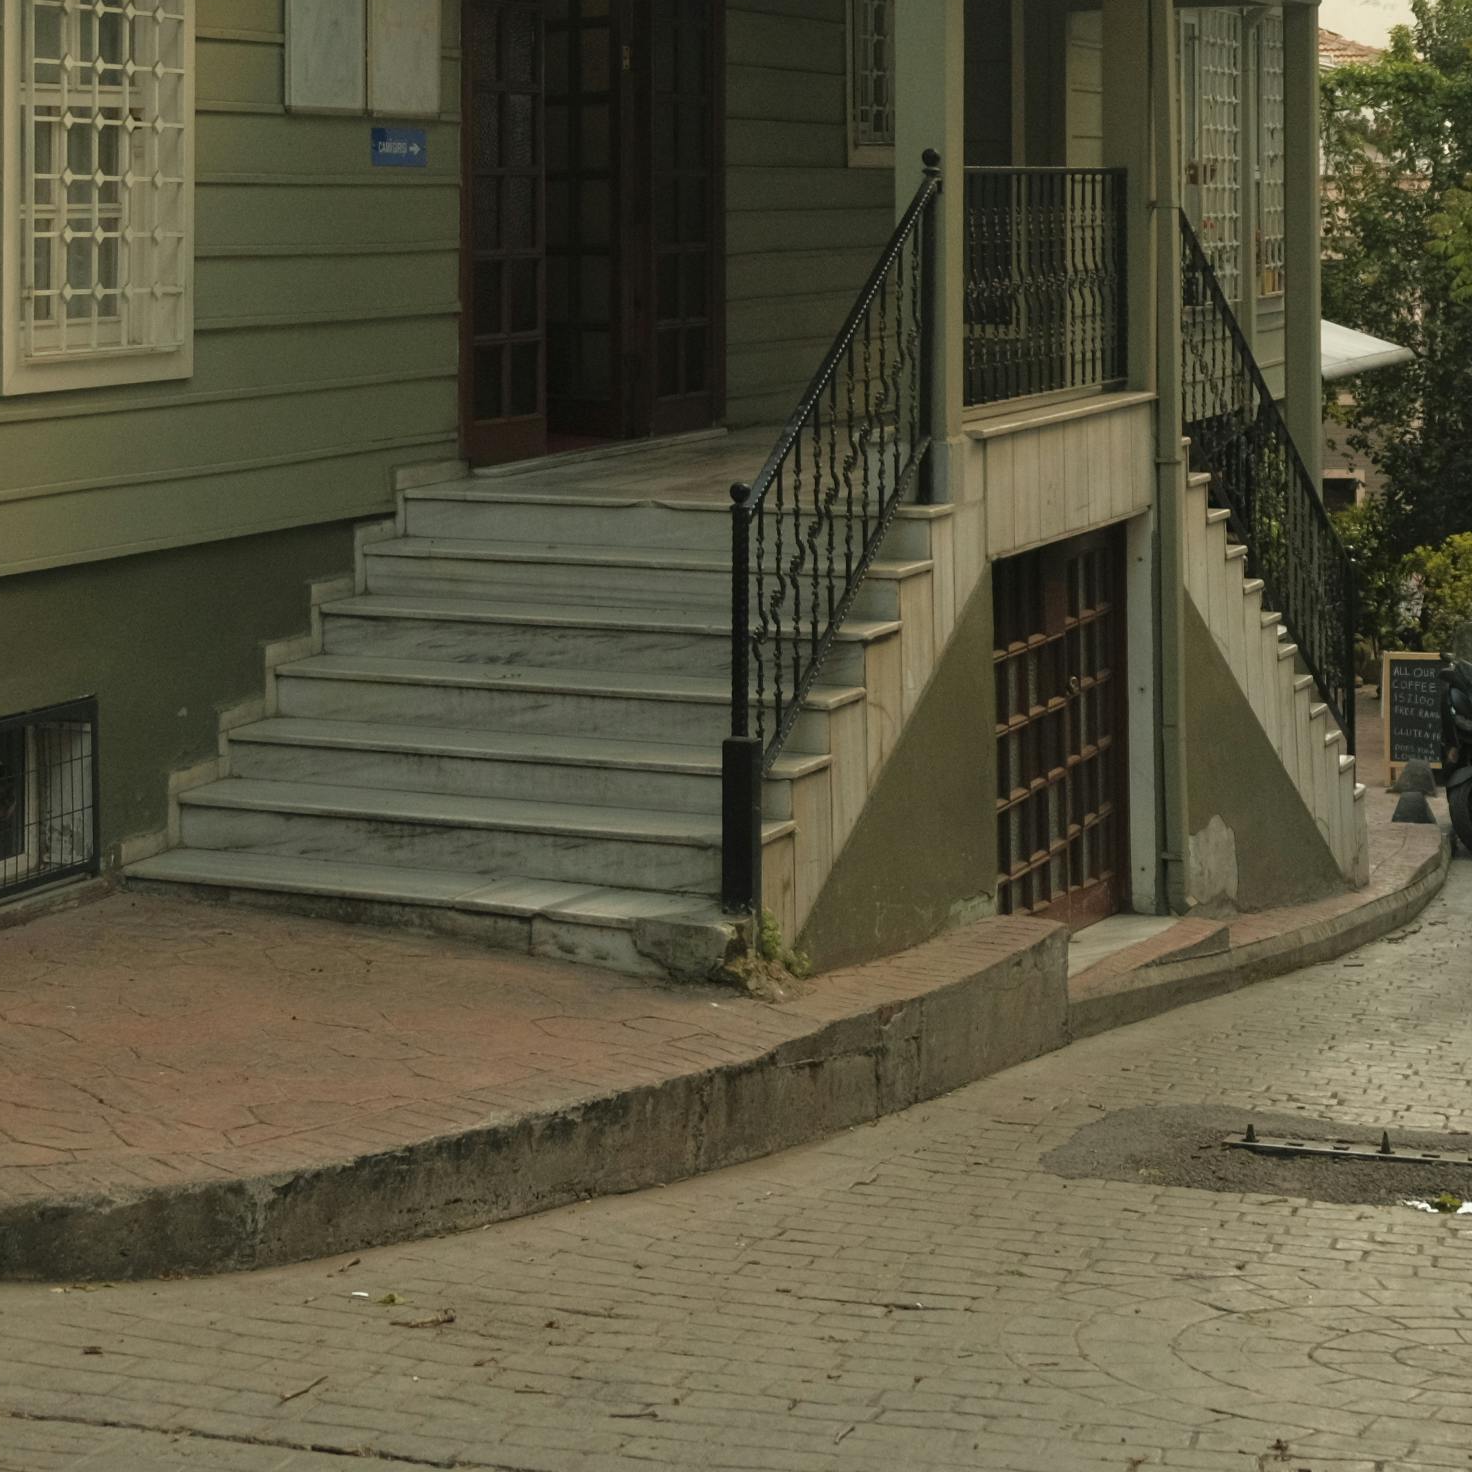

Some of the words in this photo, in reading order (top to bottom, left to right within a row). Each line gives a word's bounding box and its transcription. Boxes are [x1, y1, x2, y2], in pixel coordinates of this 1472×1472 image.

[1393, 666, 1410, 677] ALL
[1413, 667, 1436, 679] OUR
[1392, 679, 1438, 693] COFFEE
